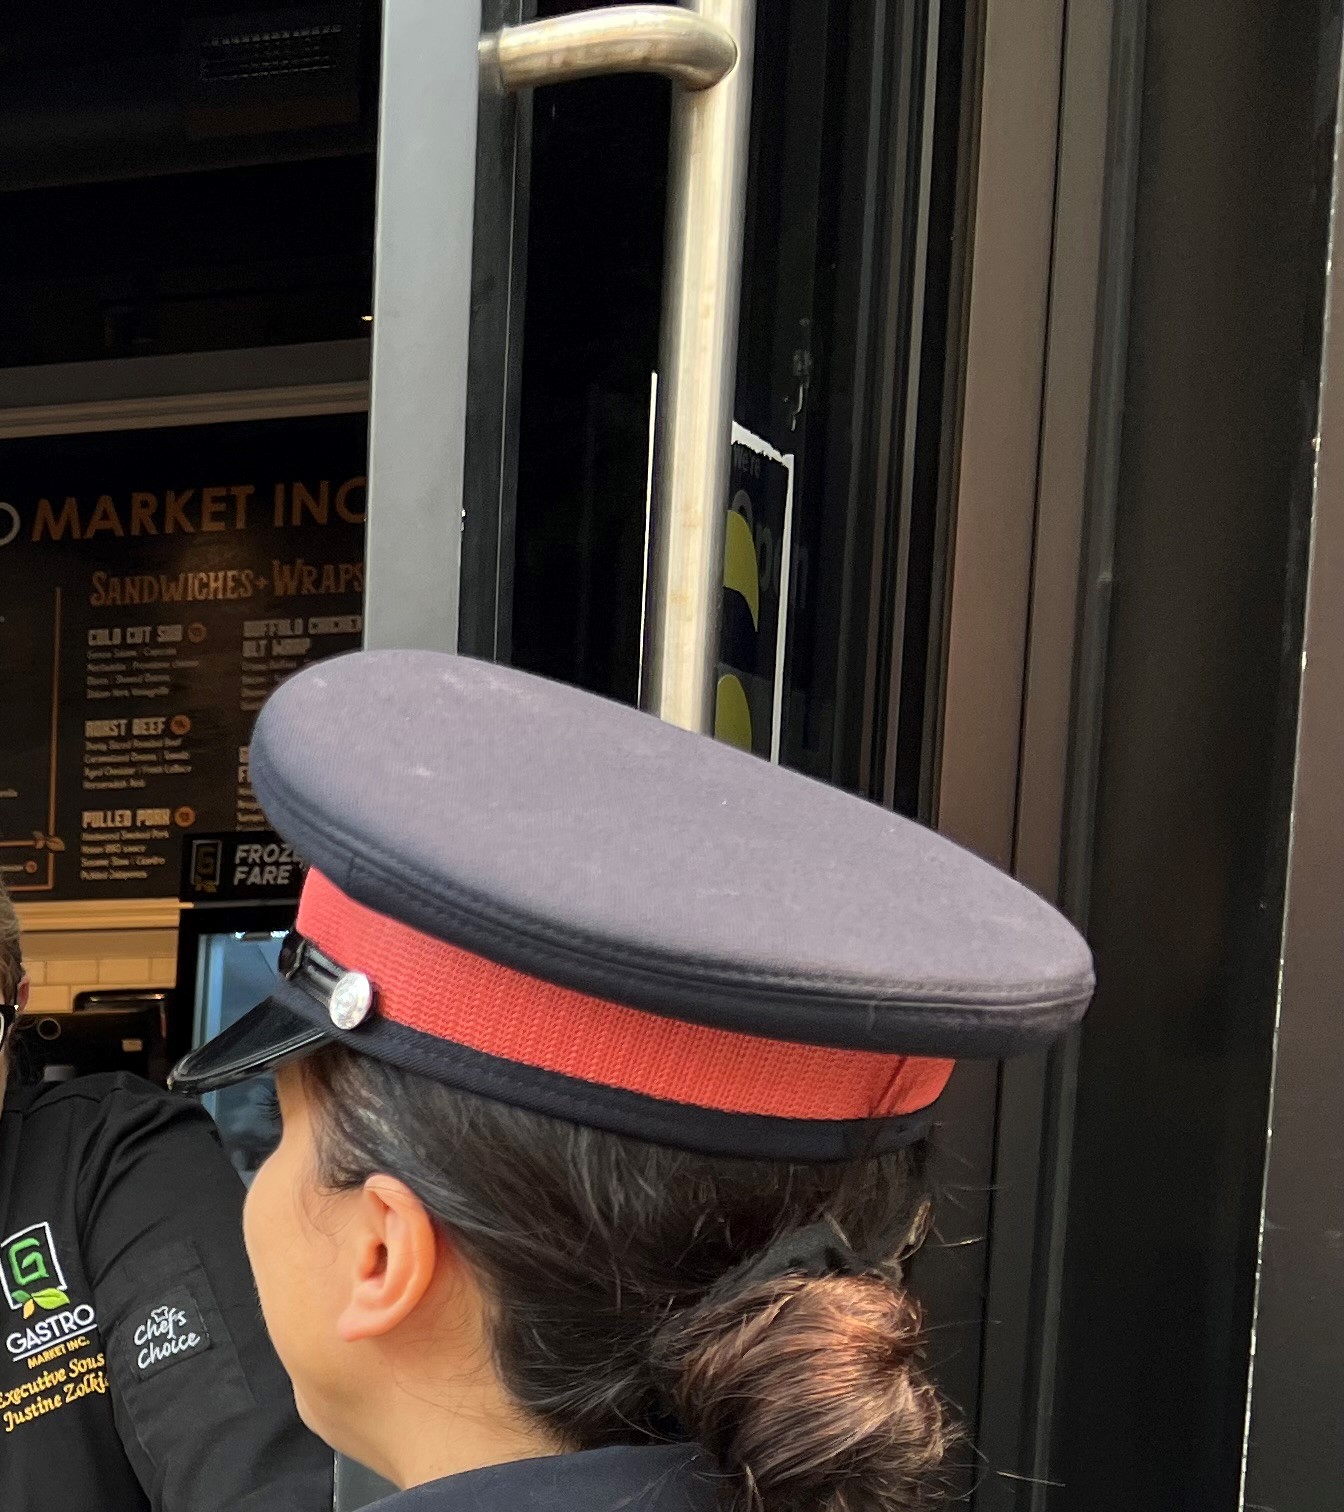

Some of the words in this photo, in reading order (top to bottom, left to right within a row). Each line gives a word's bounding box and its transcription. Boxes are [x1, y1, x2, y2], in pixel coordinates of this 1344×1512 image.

[31, 484, 255, 543] MARKET
[234, 842, 304, 872] FROZ
[233, 865, 290, 886] FARE
[6, 1304, 95, 1354] GASTRO
[27, 1344, 66, 1369] MARKET
[66, 1335, 91, 1352] INC.
[68, 1353, 105, 1377] Sous
[138, 1332, 201, 1369] Choice
[3, 1395, 62, 1432] Justine
